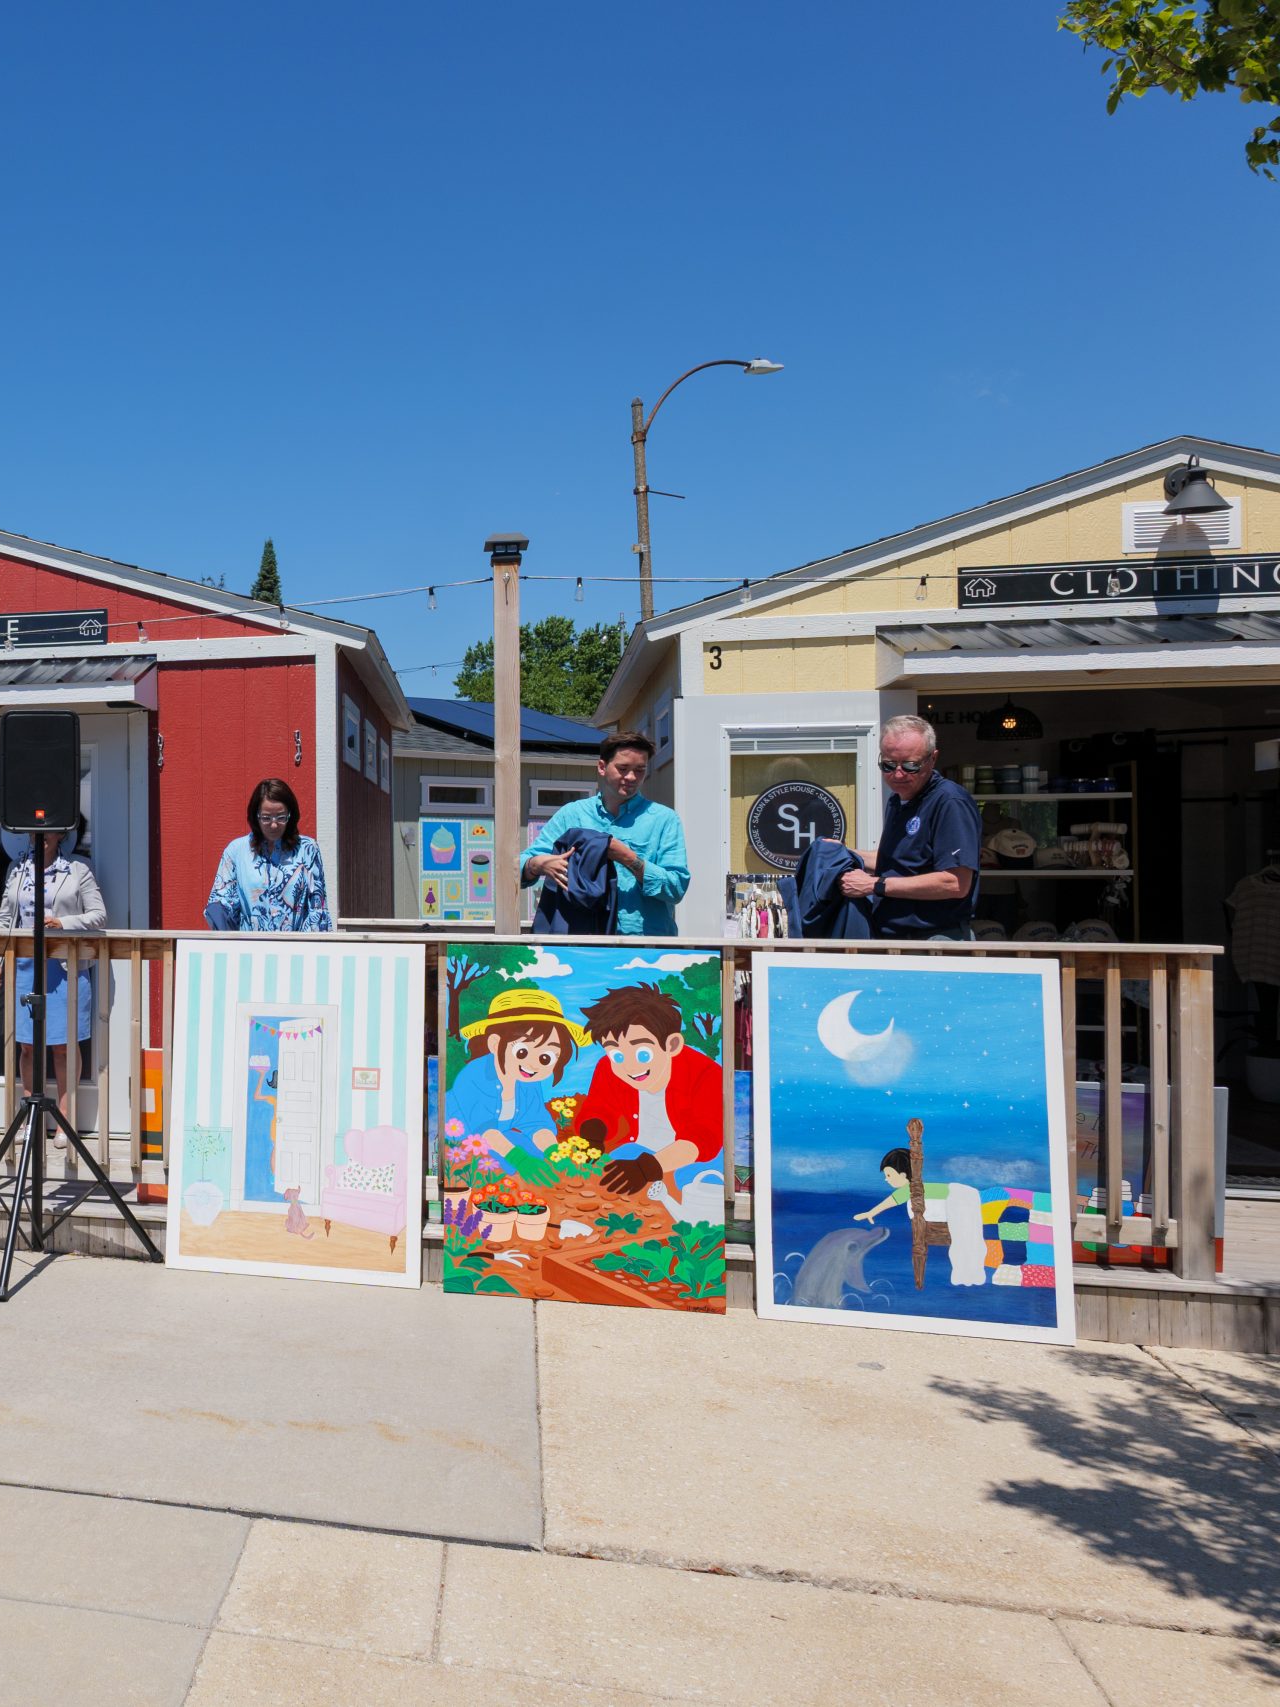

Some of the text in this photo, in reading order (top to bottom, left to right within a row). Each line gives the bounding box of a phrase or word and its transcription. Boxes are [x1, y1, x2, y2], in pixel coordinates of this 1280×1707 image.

[709, 645, 722, 670] 3
[752, 801, 767, 824] SALON
[768, 786, 790, 800] STYLE
[789, 785, 816, 795] HOUSE
[817, 793, 837, 813] SALON
[832, 818, 841, 839] STYLE
[752, 829, 765, 851] HOUSE
[763, 849, 784, 864] STYLE
